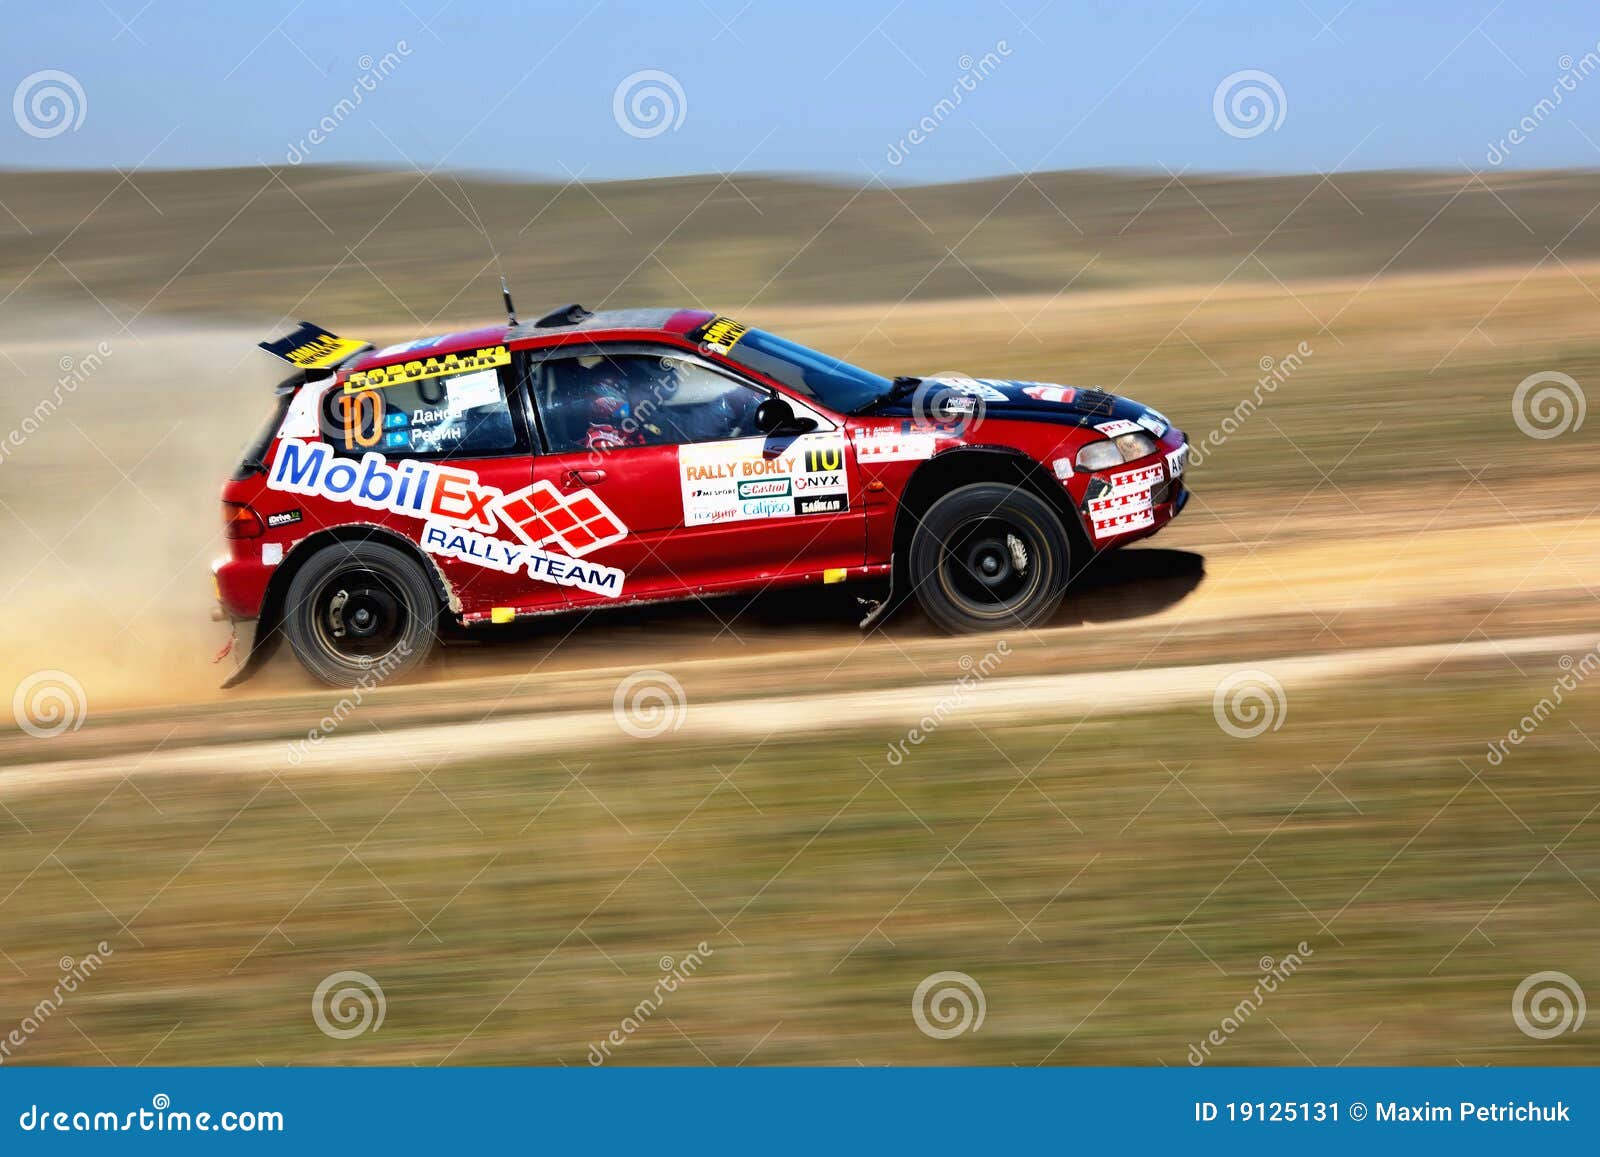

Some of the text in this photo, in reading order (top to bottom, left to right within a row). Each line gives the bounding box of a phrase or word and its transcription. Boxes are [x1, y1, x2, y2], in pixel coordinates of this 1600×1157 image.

[338, 390, 383, 450] 10
[275, 444, 498, 526] MobilEx
[686, 457, 797, 481] RALLY BORLY
[751, 481, 786, 495] Castrol
[743, 501, 790, 518] Calipso
[427, 528, 617, 589] RALLY TEAM
